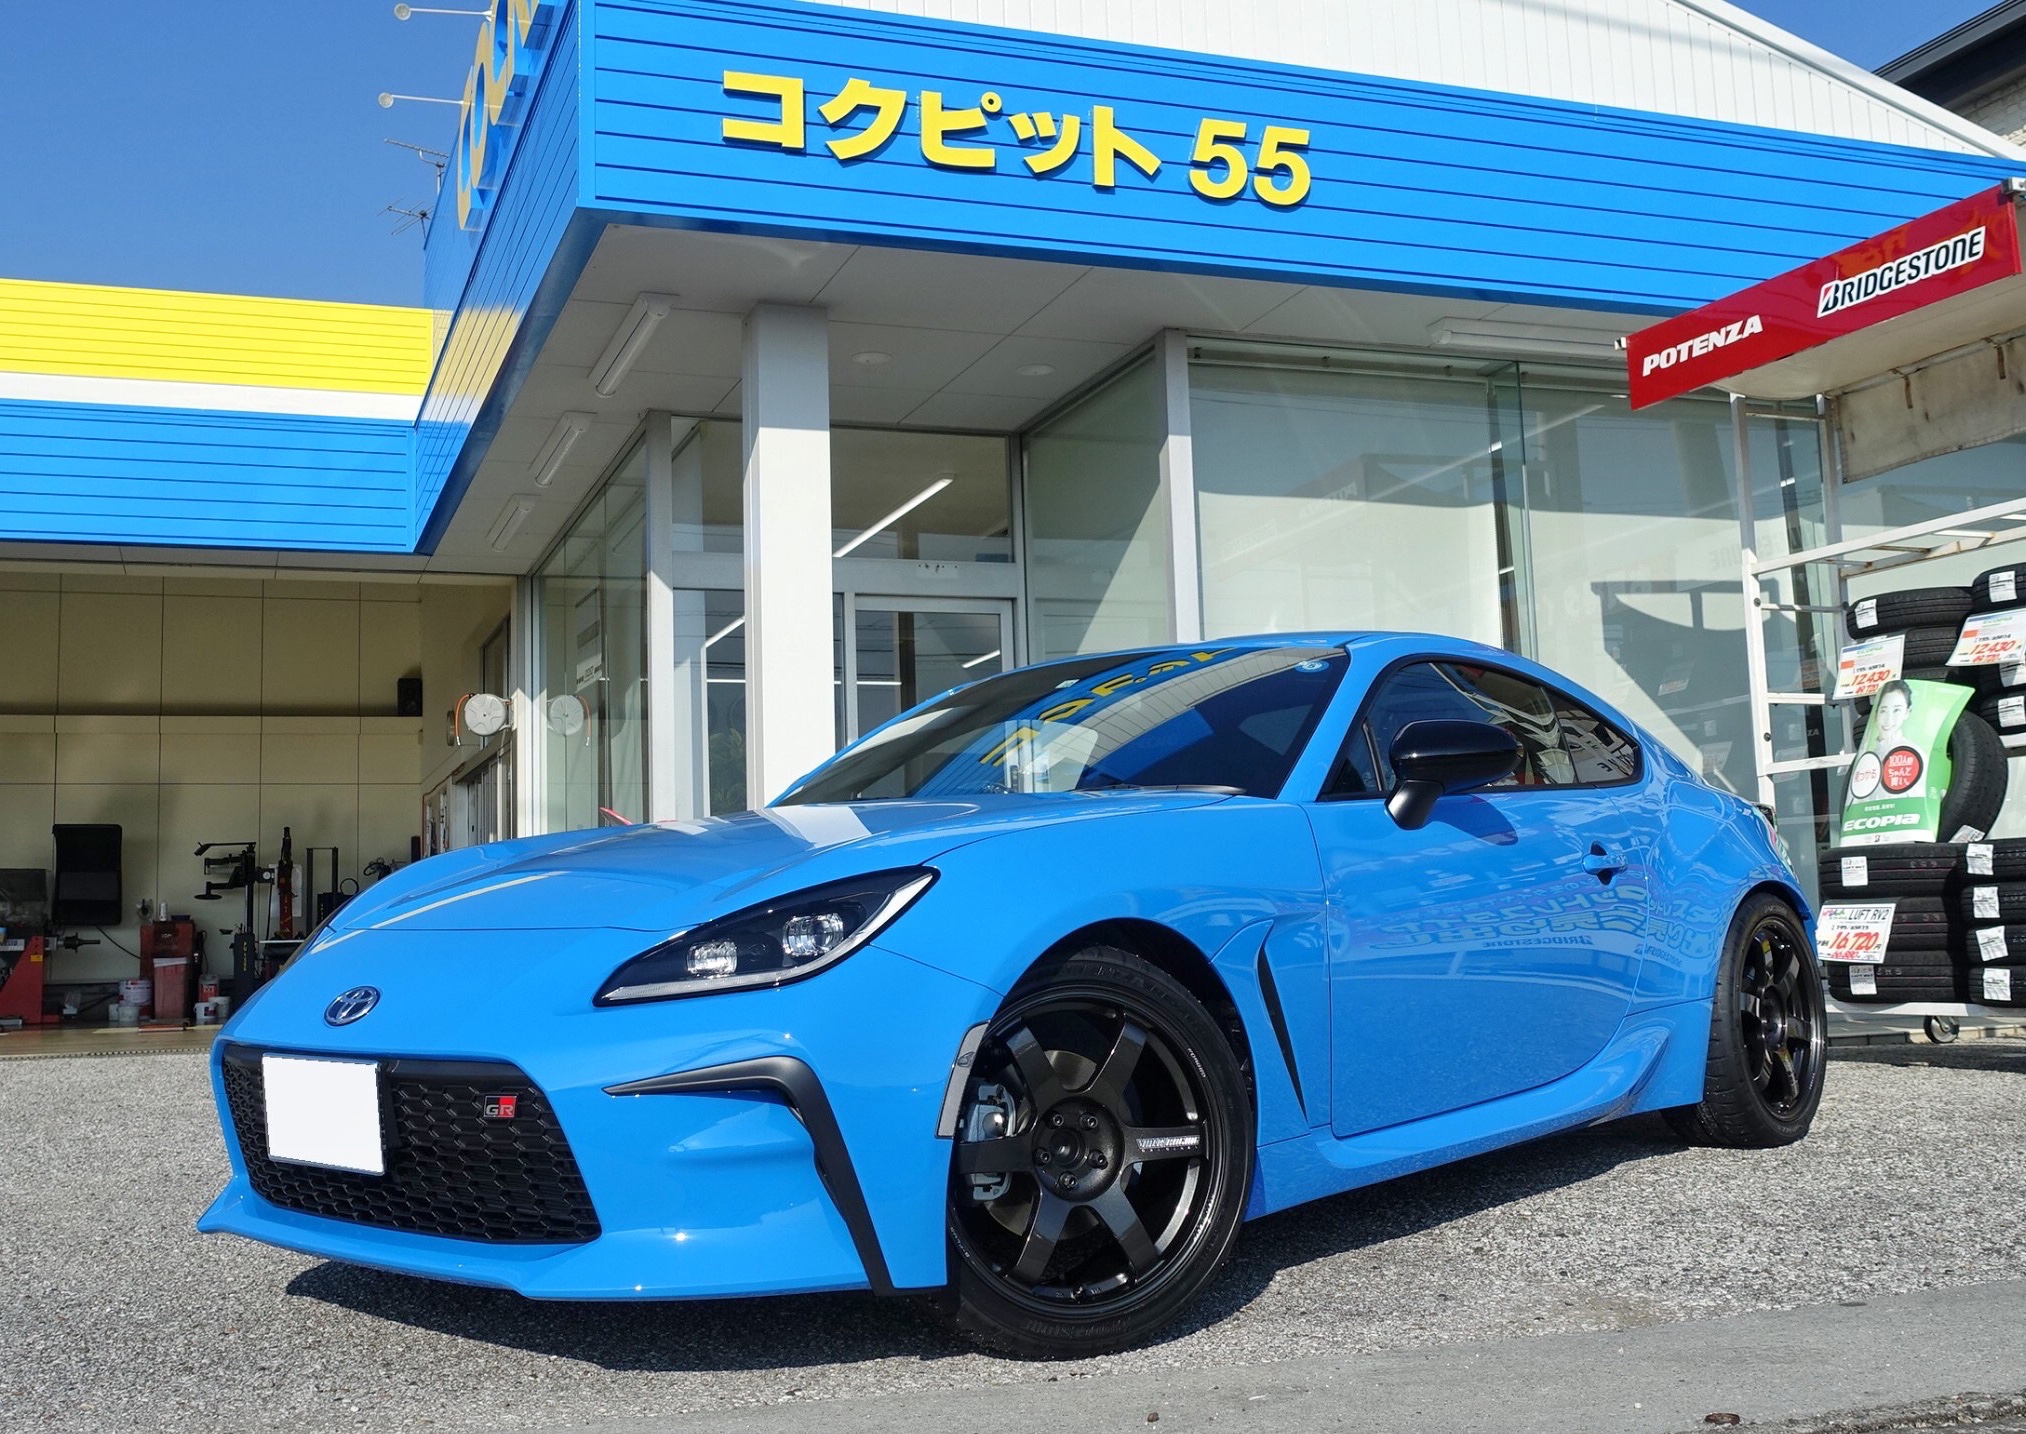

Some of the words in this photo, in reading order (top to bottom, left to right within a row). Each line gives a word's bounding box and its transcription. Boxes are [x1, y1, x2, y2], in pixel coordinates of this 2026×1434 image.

[722, 69, 1162, 187] コクピット
[1188, 116, 1312, 206] 55
[1818, 227, 1986, 317] BRIDGESTONE
[1642, 314, 1763, 377] POTENZA
[485, 1104, 514, 1116] GR
